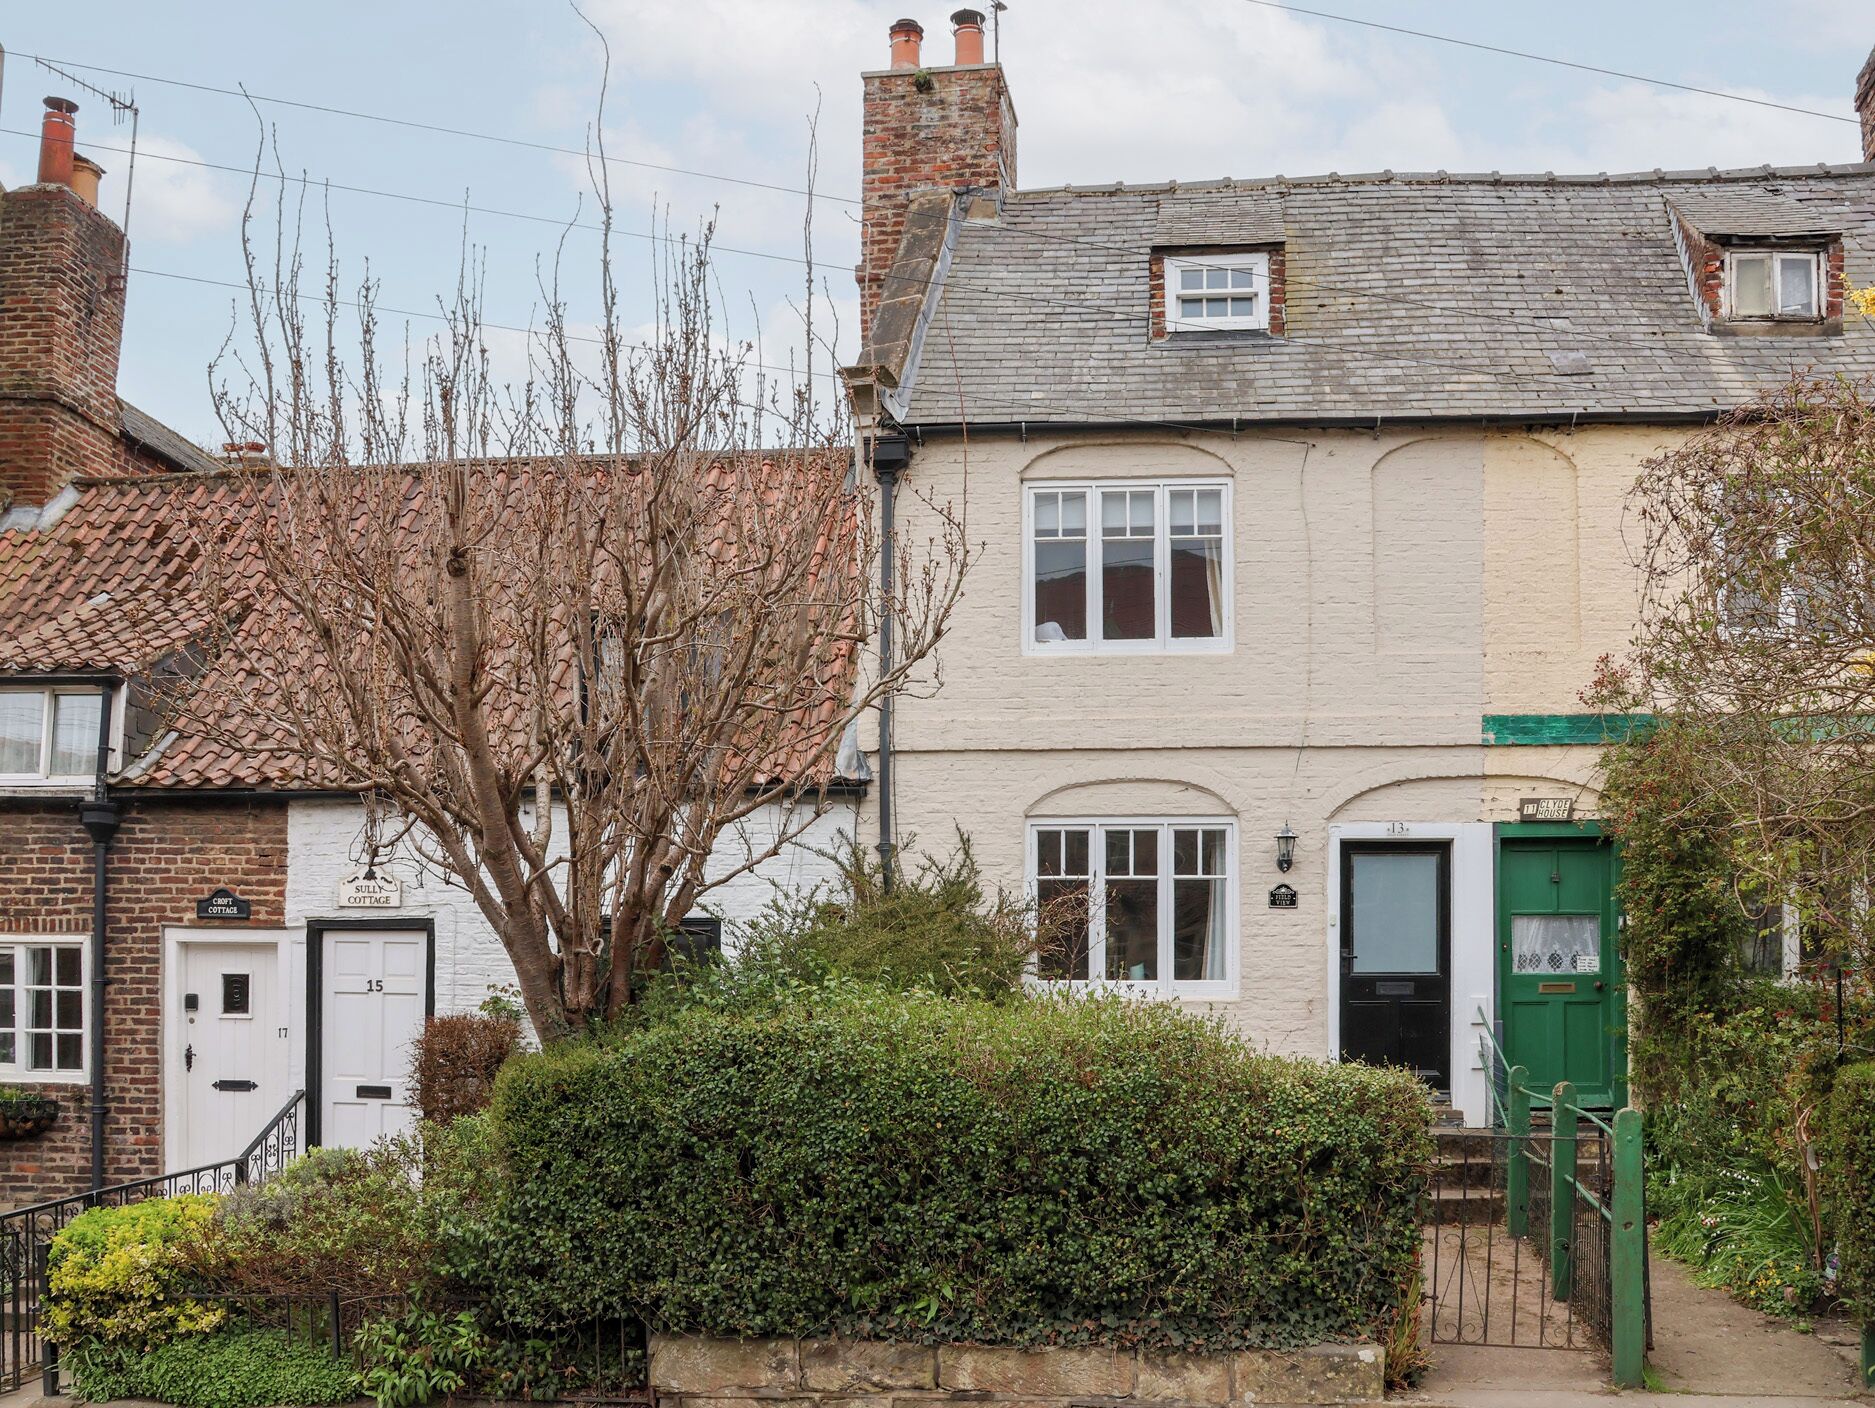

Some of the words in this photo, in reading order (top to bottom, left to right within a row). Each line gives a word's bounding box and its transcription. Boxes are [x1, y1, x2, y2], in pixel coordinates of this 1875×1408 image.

[1540, 800, 1569, 808] CLYDE
[1525, 805, 1536, 814] 11
[1538, 808, 1568, 817] HOUSE
[1392, 822, 1404, 834] 13
[354, 885, 384, 894] SULLY
[212, 897, 233, 905] CROFT
[348, 896, 391, 904] COTTAGE
[208, 906, 238, 914] COTTAGE
[367, 979, 383, 992] 15
[278, 1027, 288, 1039] 17
